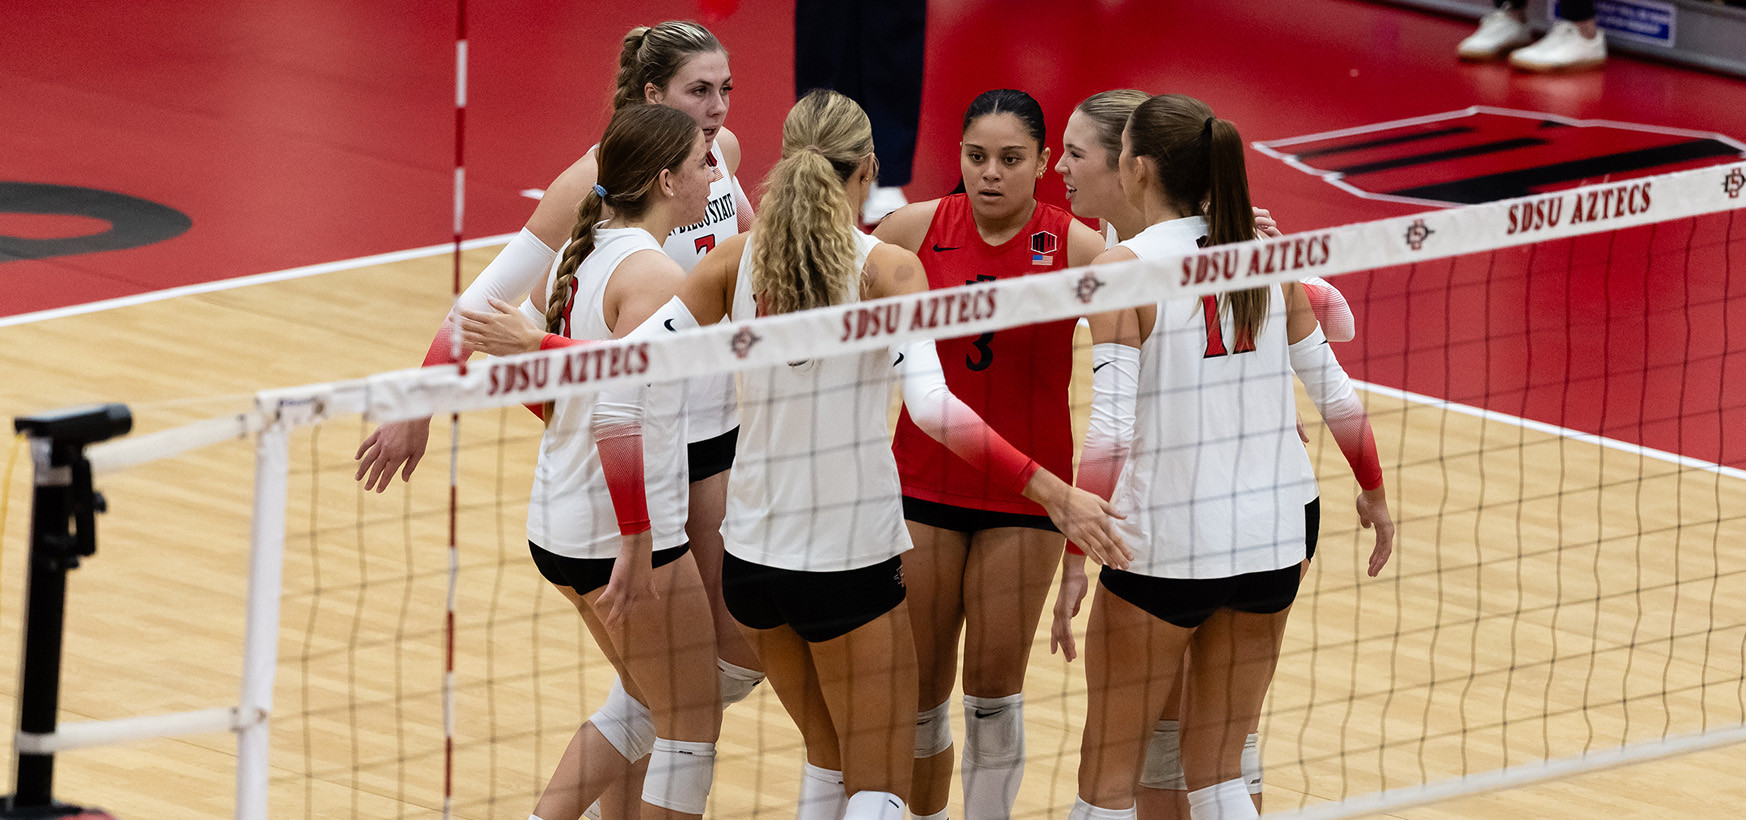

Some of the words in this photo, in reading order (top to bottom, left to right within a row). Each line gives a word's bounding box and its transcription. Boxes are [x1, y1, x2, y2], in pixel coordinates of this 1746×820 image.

[1506, 196, 1563, 235] SDSU
[1570, 181, 1652, 225] AZTECS
[1180, 248, 1239, 288] SDSU
[1246, 233, 1332, 277] AZTECS
[840, 302, 901, 343] SDSU
[908, 287, 998, 332] AZTECS
[487, 357, 549, 397] SDSU
[558, 342, 649, 387] AZTECS
